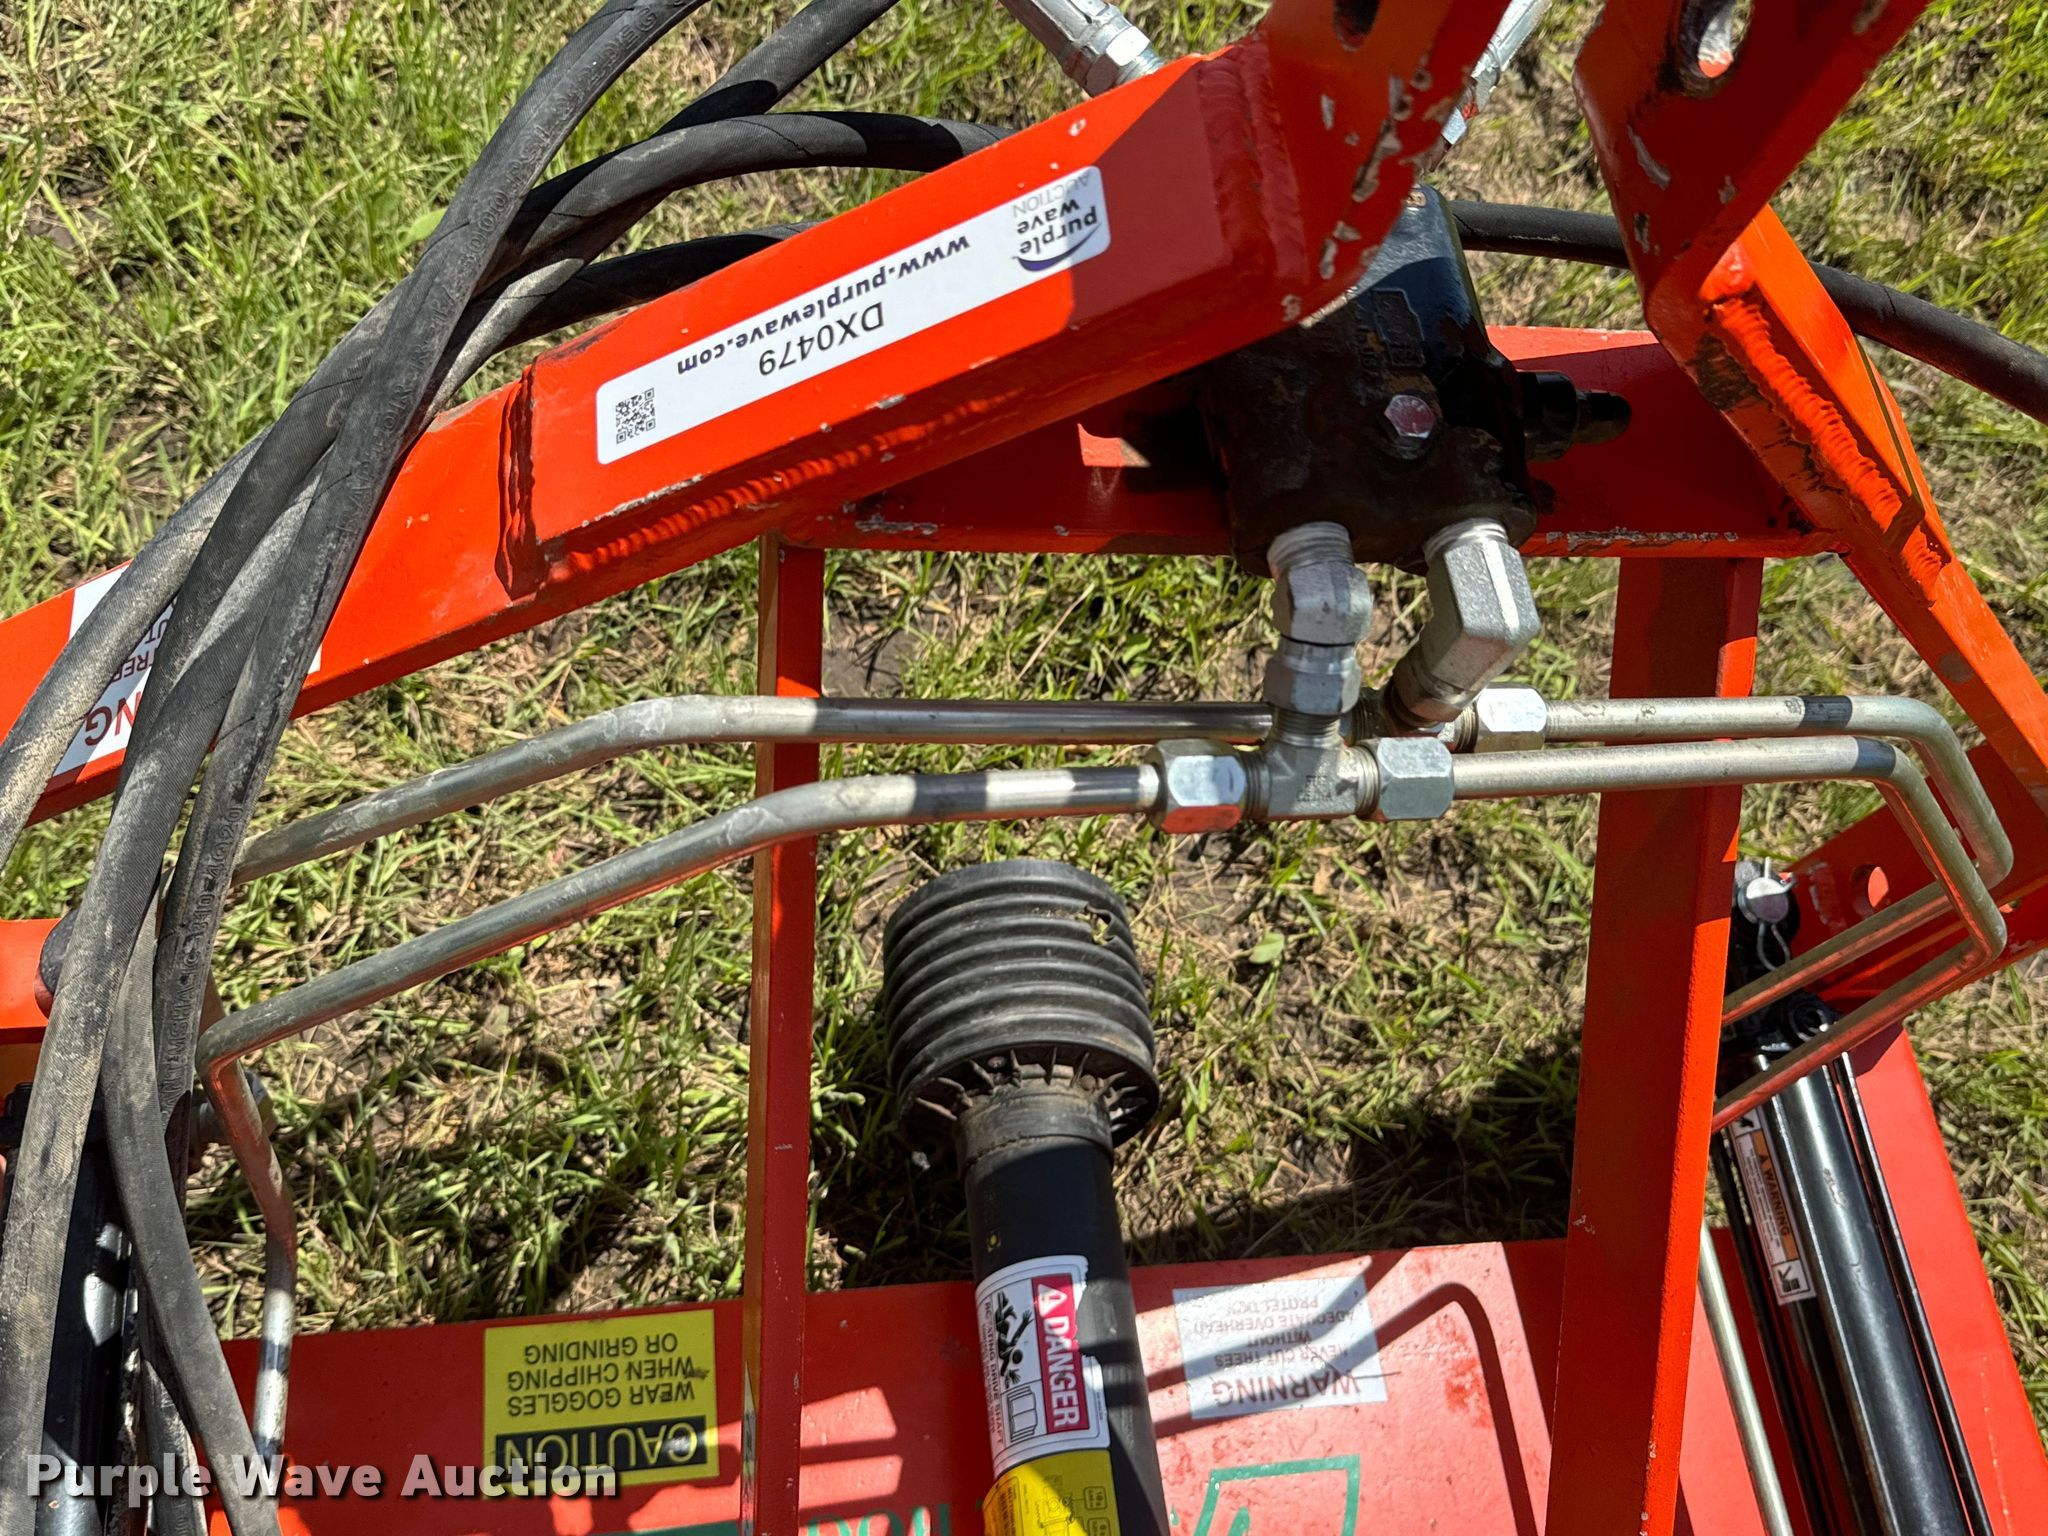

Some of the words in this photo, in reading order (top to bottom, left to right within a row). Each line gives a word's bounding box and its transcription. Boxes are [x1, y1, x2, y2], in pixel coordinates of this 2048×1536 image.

[604, 7, 659, 63] DEG
[1012, 170, 1091, 218] AUCTION
[1016, 199, 1081, 234] wave
[1018, 205, 1098, 255] purple
[677, 235, 971, 375] www.purplewave.com
[758, 301, 885, 376] DX0479
[1763, 1168, 1791, 1237] WARNING
[524, 1336, 638, 1365] GRINDING
[645, 1332, 678, 1354] OR
[1247, 1329, 1312, 1347] WITHOUT
[626, 1355, 695, 1381] WHEN
[1042, 1315, 1081, 1427] DANGER
[1214, 1350, 1264, 1368] TREES
[1265, 1347, 1296, 1365] CUT
[507, 1363, 620, 1391] CHIPPING
[629, 1380, 696, 1406] WEAR
[1211, 1371, 1361, 1407] WARNING
[507, 1387, 622, 1417] GOGGLES
[504, 1422, 698, 1475] CAUTION
